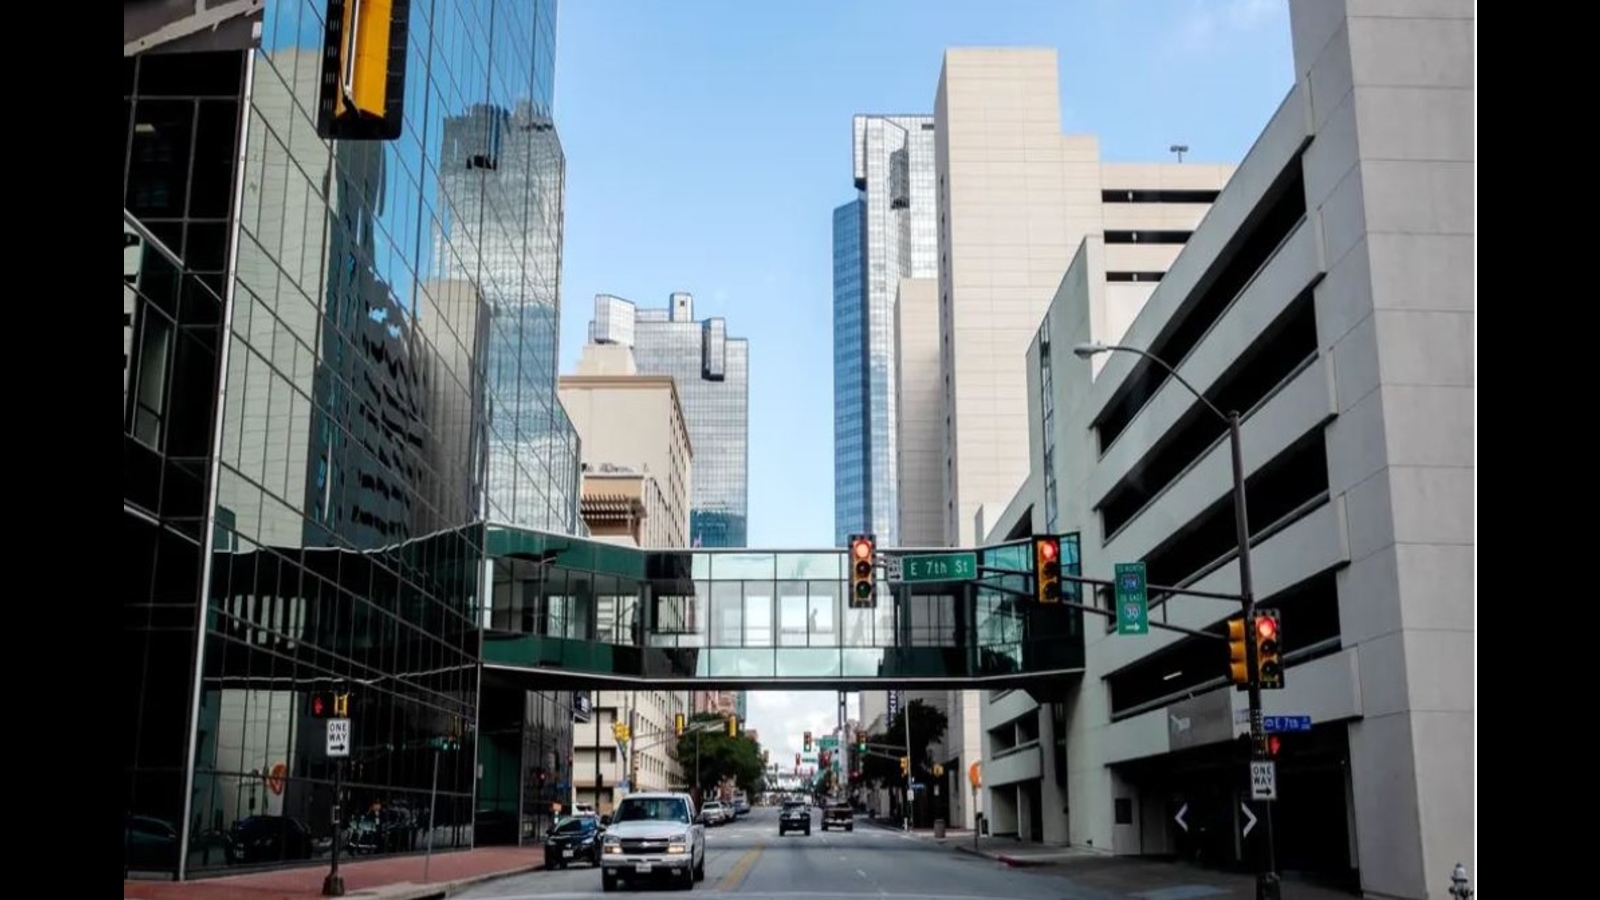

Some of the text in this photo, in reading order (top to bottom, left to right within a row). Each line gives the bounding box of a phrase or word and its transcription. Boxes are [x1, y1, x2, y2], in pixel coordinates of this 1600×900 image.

[910, 559, 968, 576] E 7th St
[329, 722, 347, 733] ONE
[1284, 717, 1299, 728] 7th
[329, 732, 347, 742] WAY
[1252, 765, 1271, 775] ONE
[1253, 775, 1272, 786] WAY
